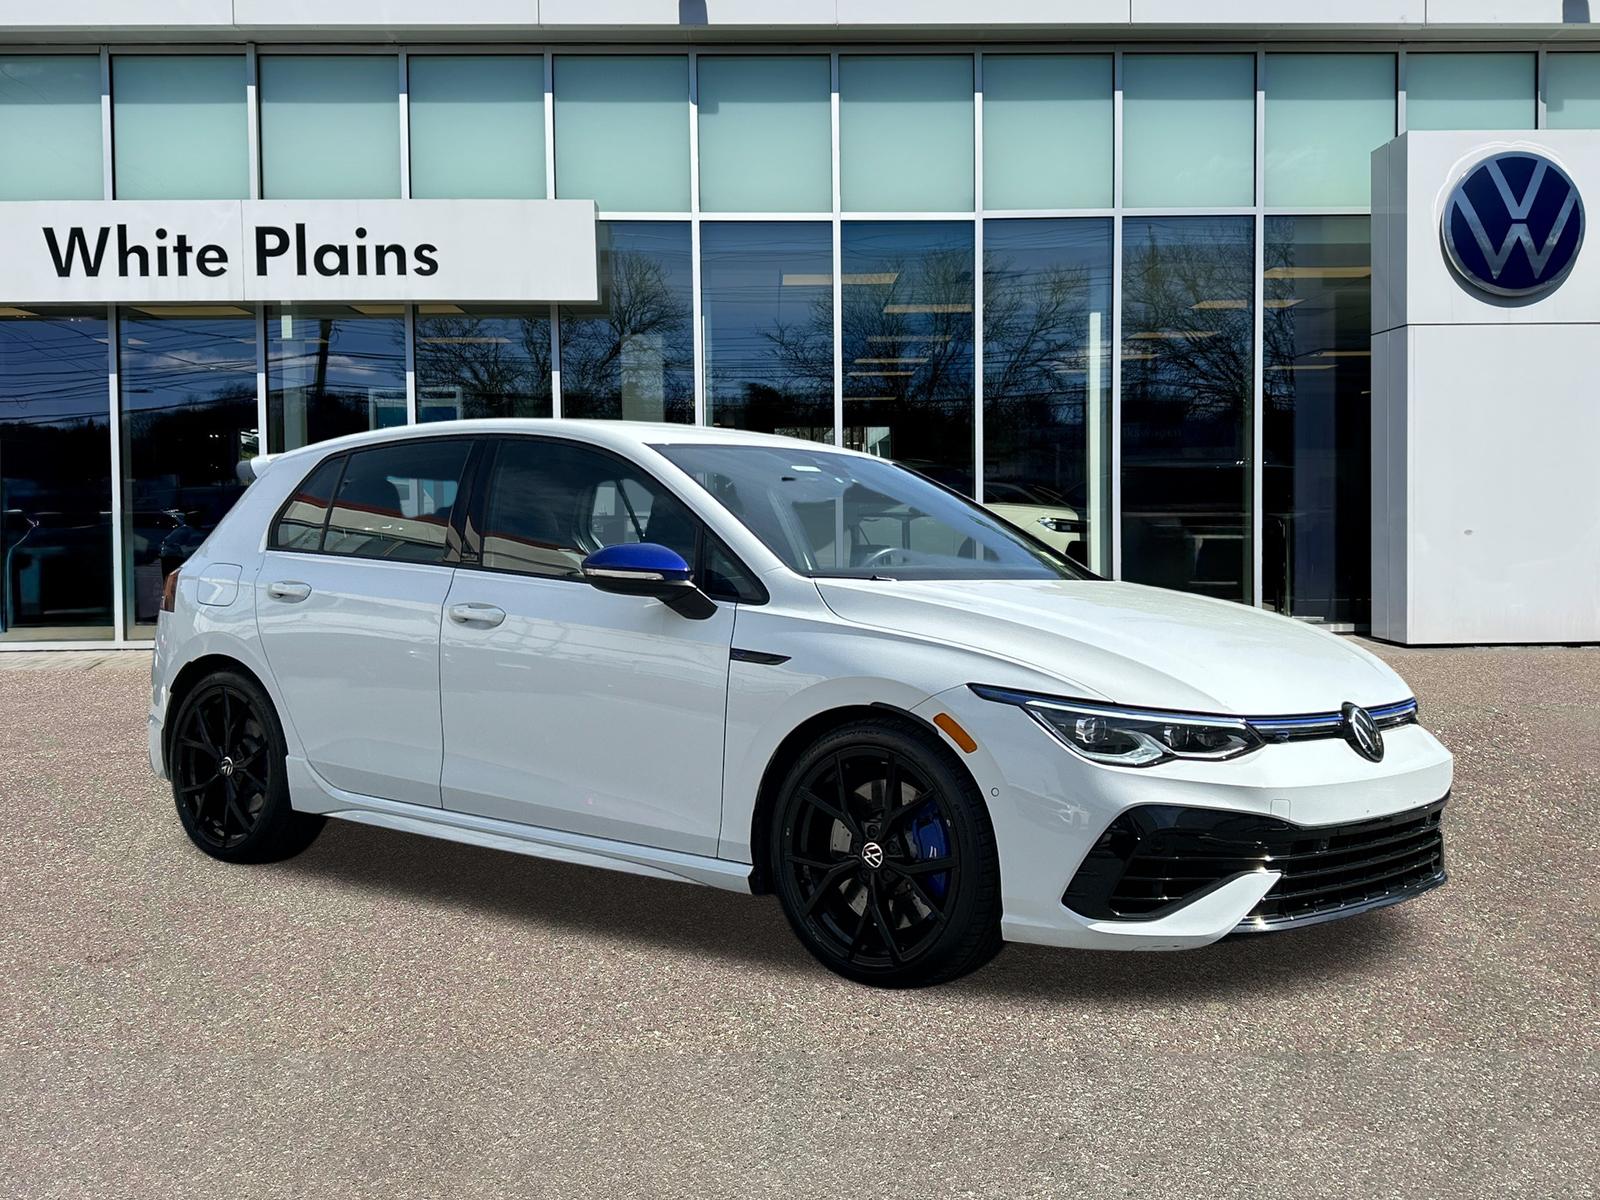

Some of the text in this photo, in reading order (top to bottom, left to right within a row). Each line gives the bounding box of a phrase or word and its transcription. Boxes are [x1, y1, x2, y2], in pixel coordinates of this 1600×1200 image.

[43, 223, 438, 278] White Plains
[1449, 155, 1579, 286] VW
